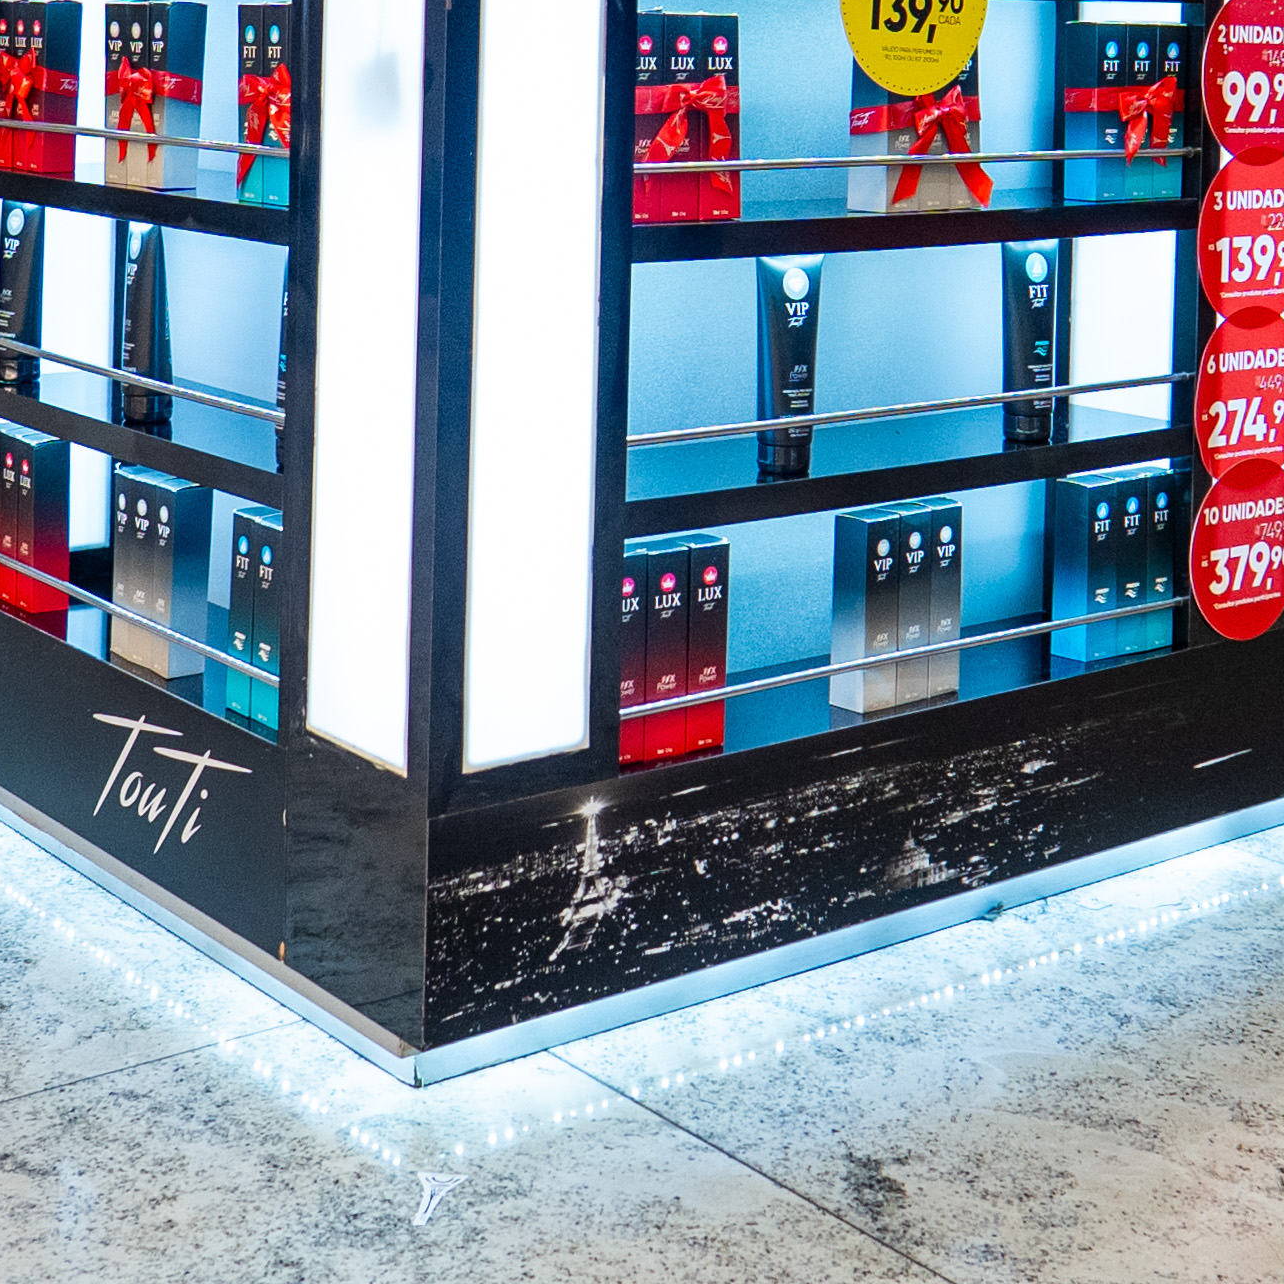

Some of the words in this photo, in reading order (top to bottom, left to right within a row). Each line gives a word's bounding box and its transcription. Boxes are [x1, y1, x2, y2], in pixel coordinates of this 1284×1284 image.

[938, 15, 961, 26] CADA
[1217, 24, 1227, 43] 2
[108, 40, 123, 52] VIP
[129, 41, 144, 54] VIP
[152, 41, 164, 53] VIP
[243, 46, 257, 59] FIT
[267, 46, 282, 60] FIT
[636, 57, 657, 70] UX
[670, 57, 695, 70] LUX
[708, 57, 733, 70] LUX
[1103, 60, 1120, 72] FIT
[1134, 60, 1151, 72] FIT
[1164, 61, 1181, 72] FIT
[1213, 191, 1223, 211] 3
[4, 238, 20, 250] VIP
[127, 263, 138, 276] VIP
[1029, 284, 1049, 299] FIT
[785, 302, 810, 316] VIP
[1207, 354, 1216, 375] 6
[117, 510, 128, 524] VIP
[134, 516, 149, 531] VIP
[1124, 514, 1141, 528] FIT
[1154, 510, 1169, 523] FIT
[1203, 507, 1219, 526] 10
[158, 524, 171, 538] VIP
[1094, 520, 1111, 534] FIT
[906, 550, 925, 564] VIP
[937, 544, 956, 558] VIP
[236, 556, 249, 570] FIT
[874, 558, 893, 572] VIP
[259, 565, 273, 580] FIT
[654, 593, 681, 610] LUX
[697, 586, 723, 603] LUX
[622, 597, 640, 613] UX
[93, 713, 253, 854] TouTi
